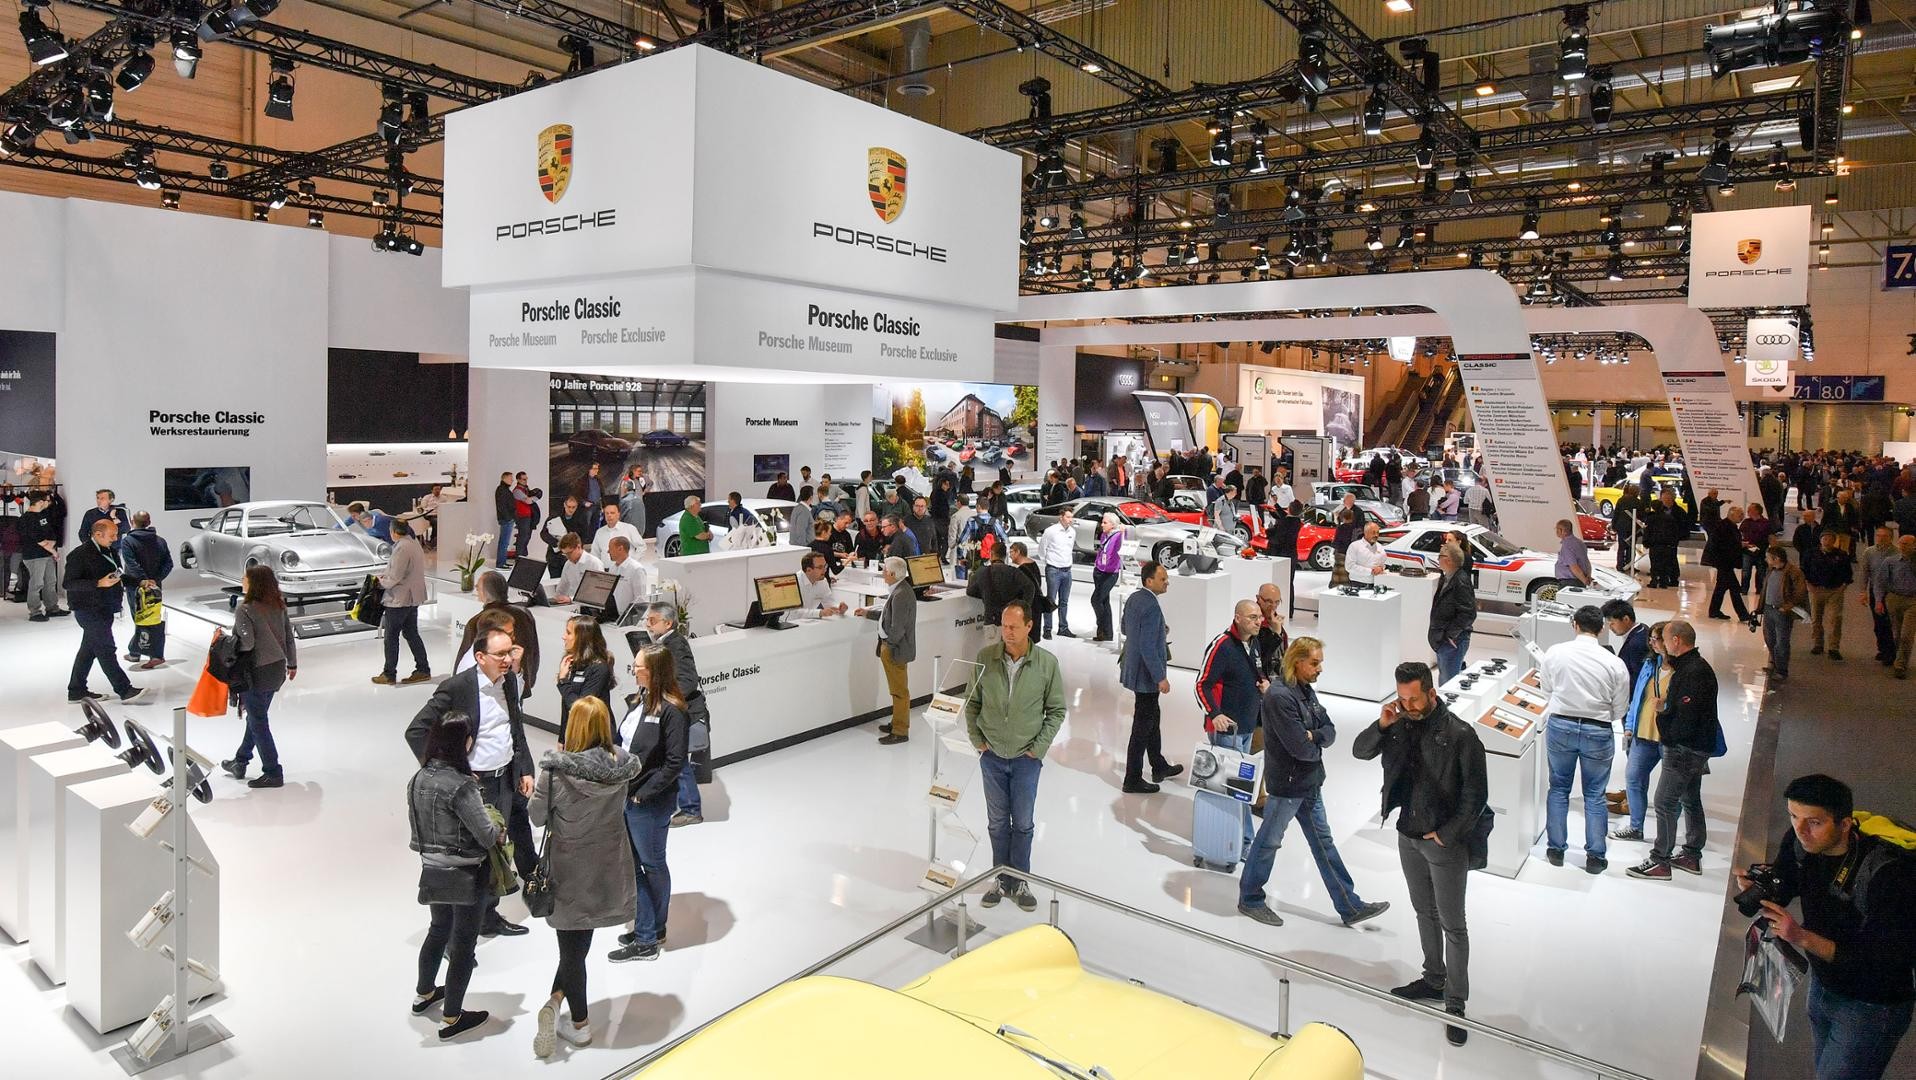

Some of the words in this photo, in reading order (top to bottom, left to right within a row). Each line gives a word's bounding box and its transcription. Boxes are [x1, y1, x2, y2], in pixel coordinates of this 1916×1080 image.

[496, 209, 616, 241] PORSCHE
[814, 222, 947, 263] PORSCHE
[1706, 268, 1792, 278] PORSCHE
[1892, 252, 1916, 279] 7.
[522, 300, 570, 322] Porsche
[574, 296, 621, 320] Classic
[808, 304, 868, 331] Porsche
[874, 312, 920, 336] Classic
[489, 332, 520, 348] Porsche
[522, 332, 556, 346] Museum
[581, 329, 618, 344] Porsche
[620, 326, 666, 344] Exclusive
[758, 331, 804, 350] Porsche
[808, 335, 852, 354] Museum
[880, 342, 916, 360] Porsche
[920, 346, 958, 362] Exclusive
[550, 379, 562, 389] 40
[564, 380, 587, 390] Jahre
[590, 380, 624, 391] Porsche
[626, 382, 642, 392] 928
[1794, 386, 1810, 399] 7.1
[1822, 386, 1845, 399] 8.0
[150, 410, 210, 424] Porsche
[215, 411, 265, 424] Classic
[746, 418, 771, 426] Porsche
[772, 418, 798, 426] Museum
[150, 426, 250, 436] Werksrestaurierung
[954, 616, 976, 627] Porsche
[732, 664, 760, 678] Classic
